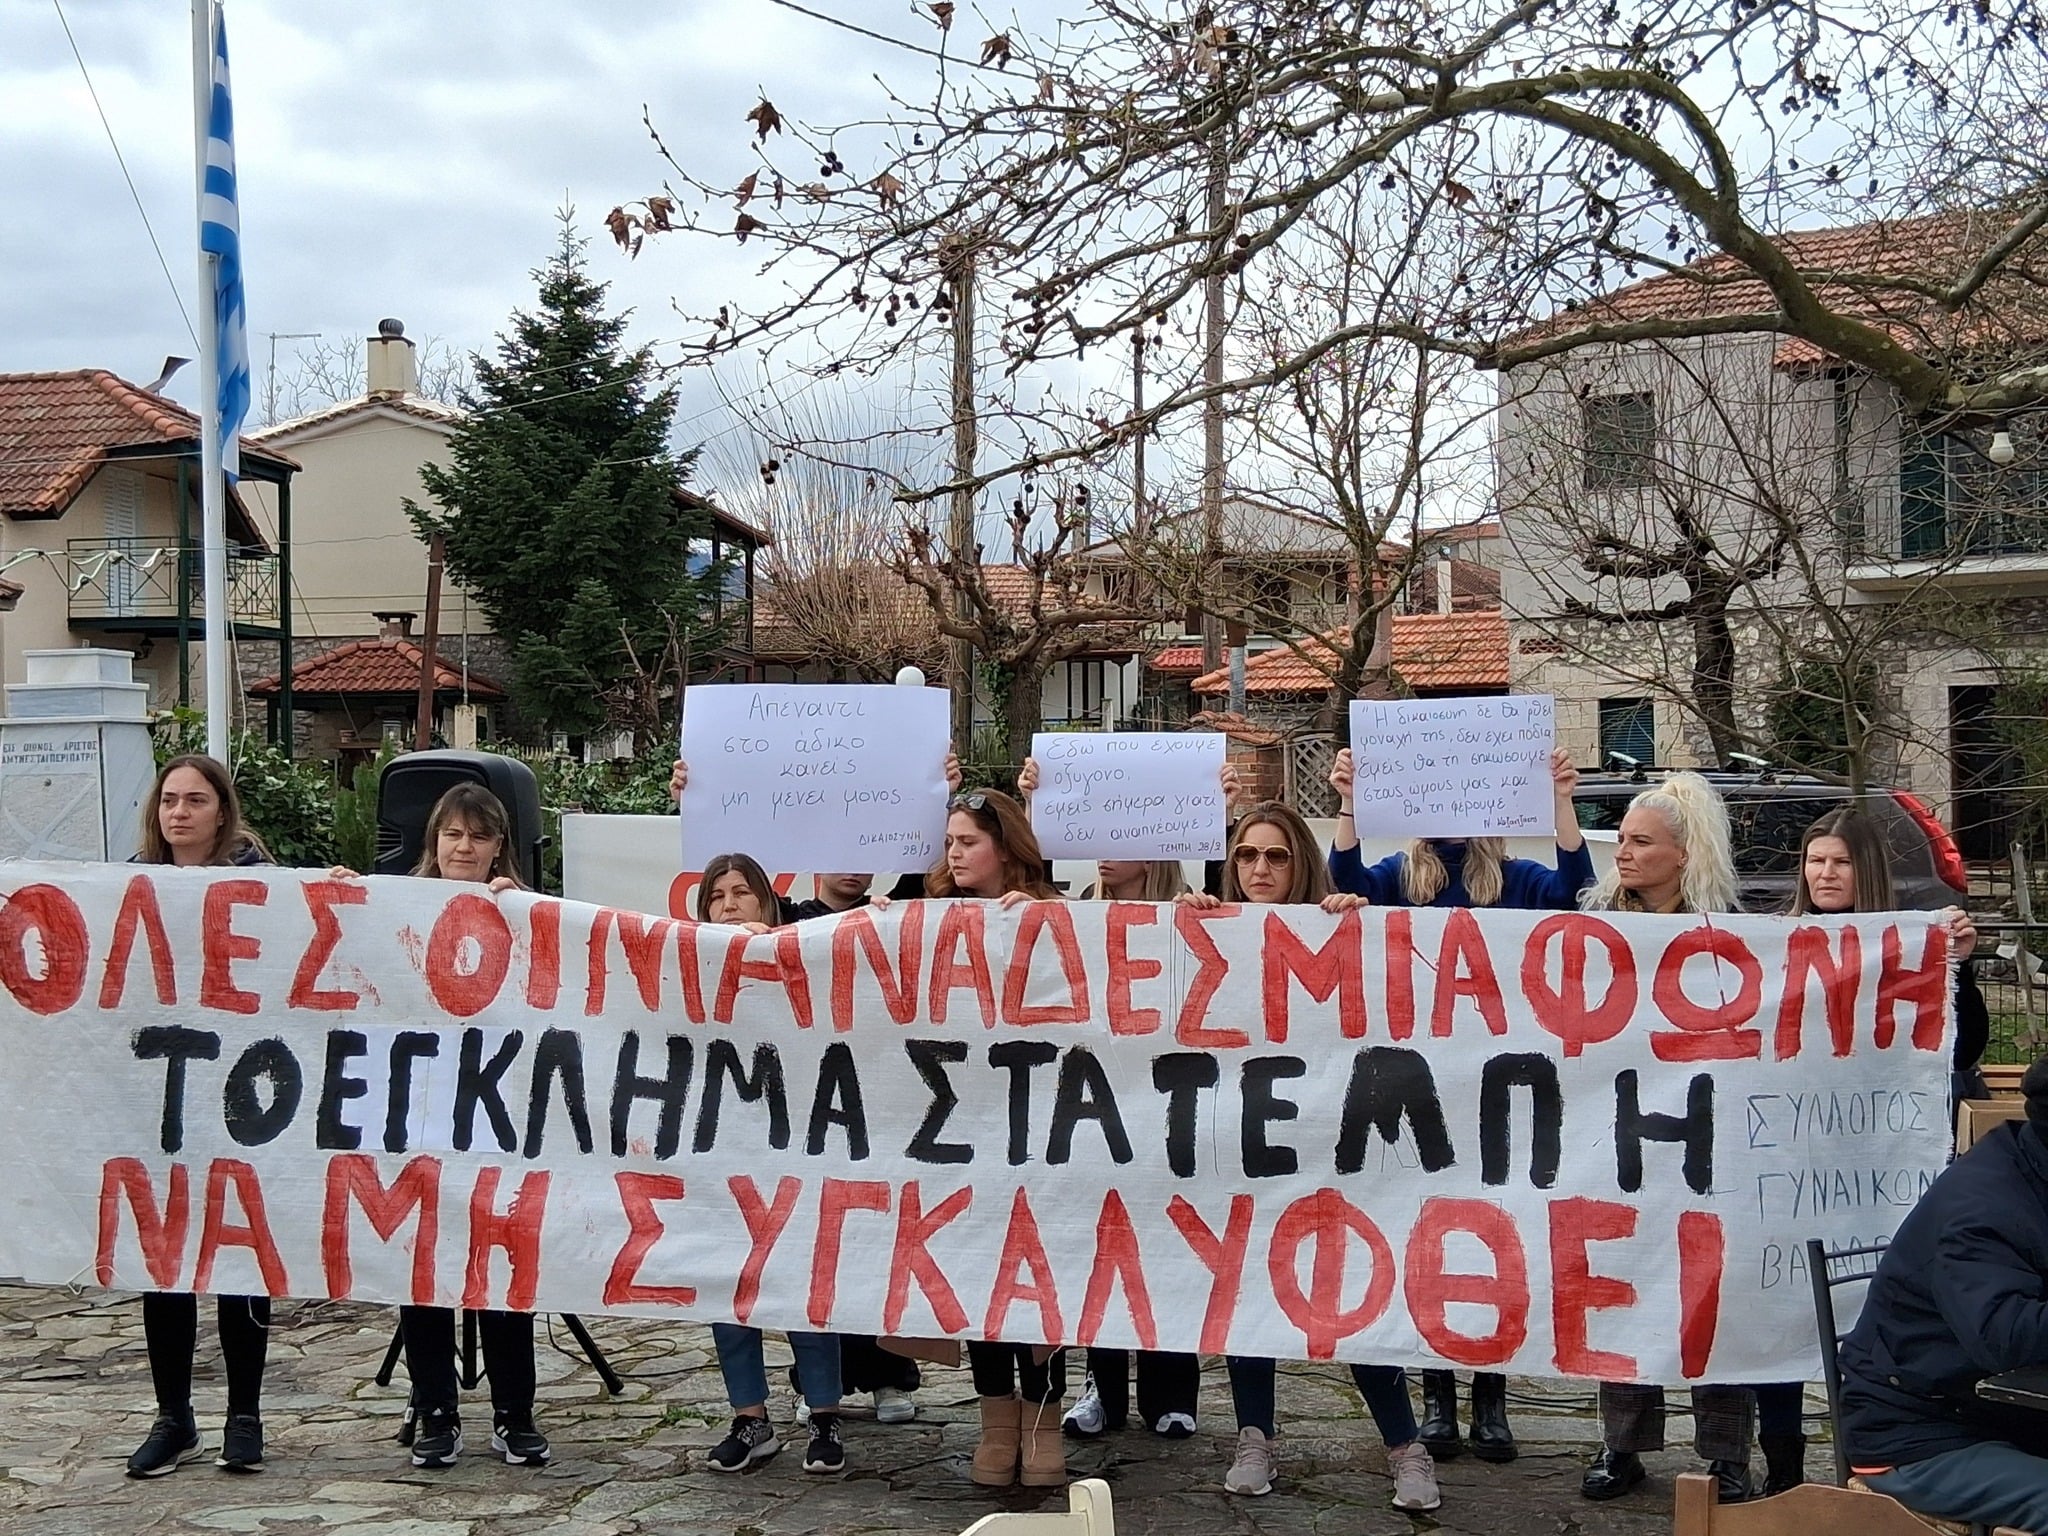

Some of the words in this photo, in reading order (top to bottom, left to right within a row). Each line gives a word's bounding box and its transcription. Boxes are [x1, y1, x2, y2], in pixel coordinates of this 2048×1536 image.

[1477, 704, 1493, 718] δε
[1502, 701, 1519, 718] θα
[724, 736, 769, 754] στο
[795, 728, 865, 754] άδικο
[1456, 728, 1480, 743] δεν
[1046, 738, 1094, 760] Εδώ
[1106, 740, 1139, 751] που
[780, 756, 857, 777] κανείς
[1414, 753, 1436, 771] θα
[1364, 786, 1403, 802] στους
[1461, 777, 1490, 797] μας
[1501, 775, 1528, 788] και
[721, 790, 749, 816] μη
[1103, 794, 1165, 817] σήμερα
[1174, 790, 1217, 815] γιατί
[1403, 799, 1422, 817] θα
[1429, 803, 1444, 813] τη
[859, 831, 921, 846] ΔΙΚΑΙΟΣΥΝΗ
[1064, 823, 1095, 842] δεν
[1158, 843, 1191, 853] ΤΕΜΠΗ
[0, 874, 369, 1016] ΟΛΕΣ
[425, 892, 563, 1017] ΟΙ
[1262, 906, 1509, 1044] ΜΙΑ
[1520, 911, 1948, 1062] ΦΩΝΗ
[131, 1024, 303, 1155] ΤΟ
[316, 1025, 870, 1161] ΕΓΚΛΗΜΑ
[903, 1039, 1134, 1166] ΣΤΑ
[1151, 1045, 1715, 1195] ΤΕΜΠΗ
[1747, 1090, 1928, 1149] ΣΥΛΛΟΓΟΣ
[96, 1156, 289, 1297] ΝΑ
[322, 1153, 552, 1311] ΜΗ
[602, 1170, 1726, 1379] ΣΥΓΚΑΛΥΦΘΕΙ
